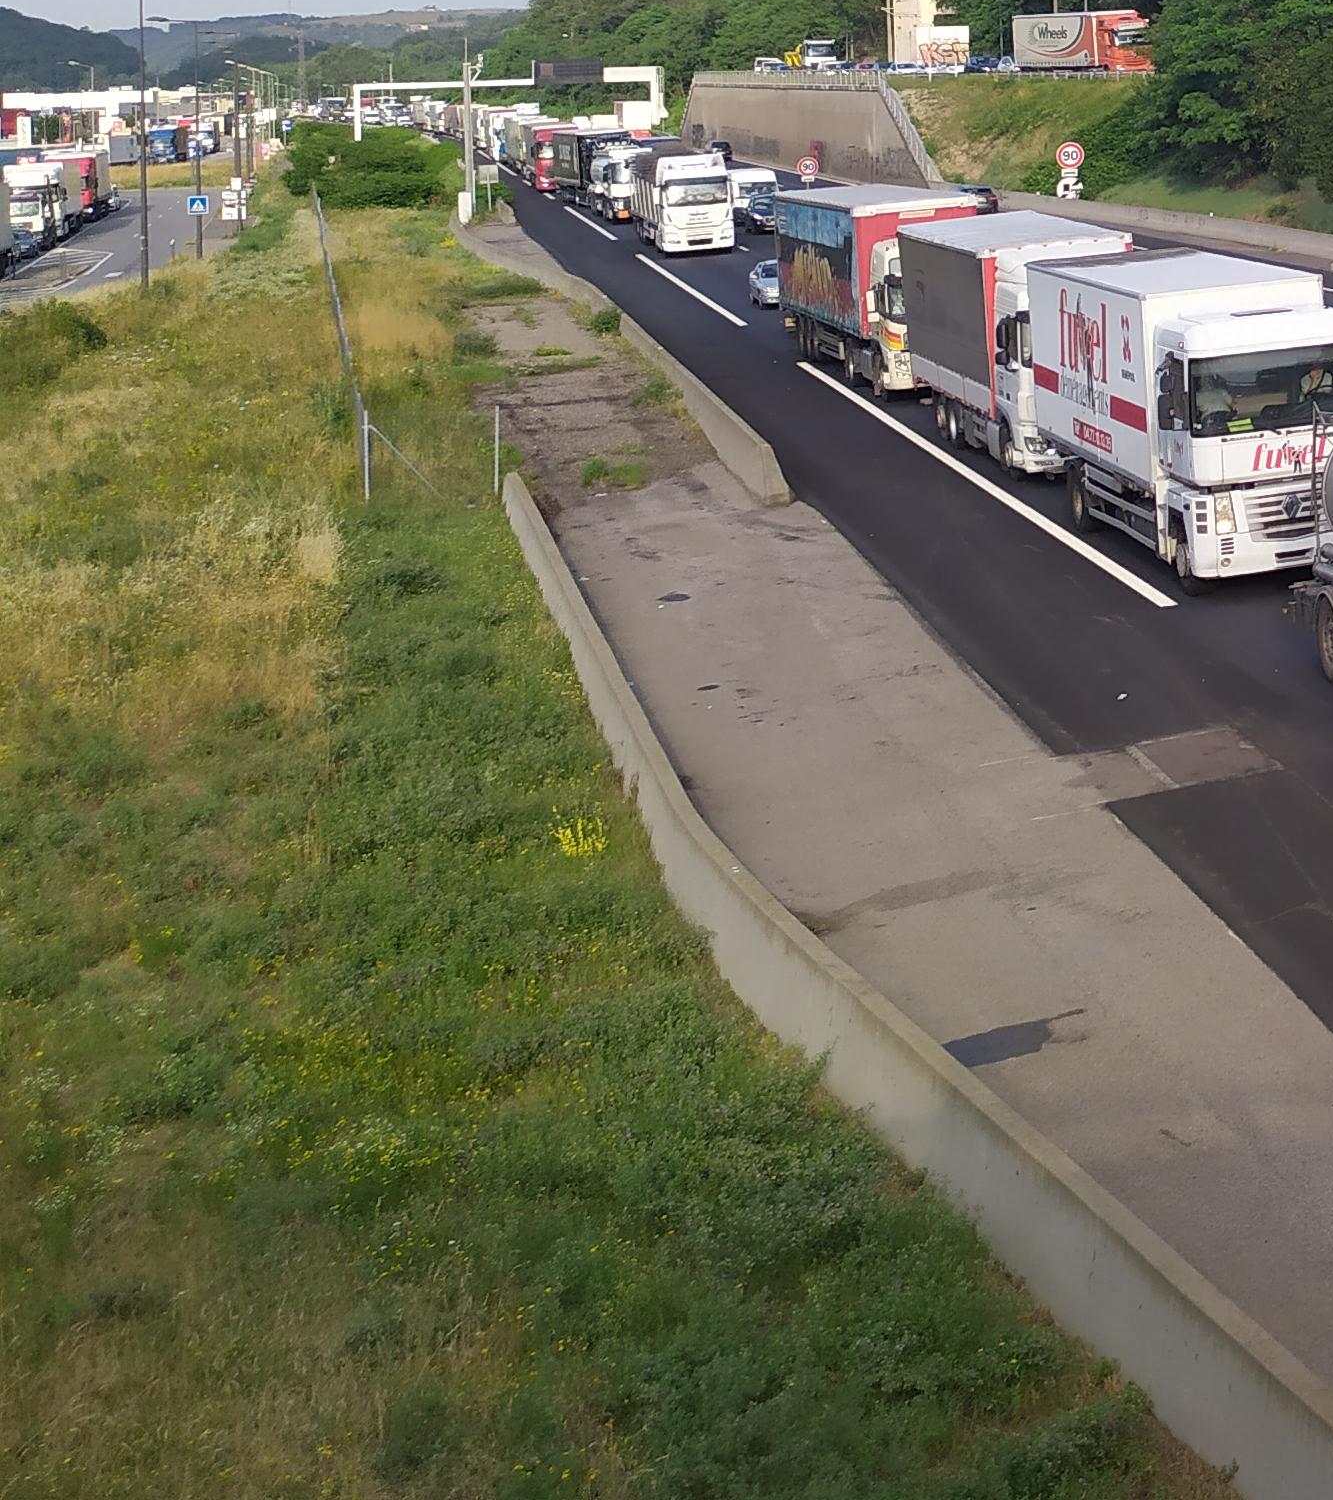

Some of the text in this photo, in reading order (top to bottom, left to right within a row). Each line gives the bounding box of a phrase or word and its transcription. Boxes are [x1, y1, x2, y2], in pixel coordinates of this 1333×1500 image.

[1037, 24, 1068, 40] Wheels
[1062, 150, 1079, 162] 90
[802, 162, 814, 172] 90
